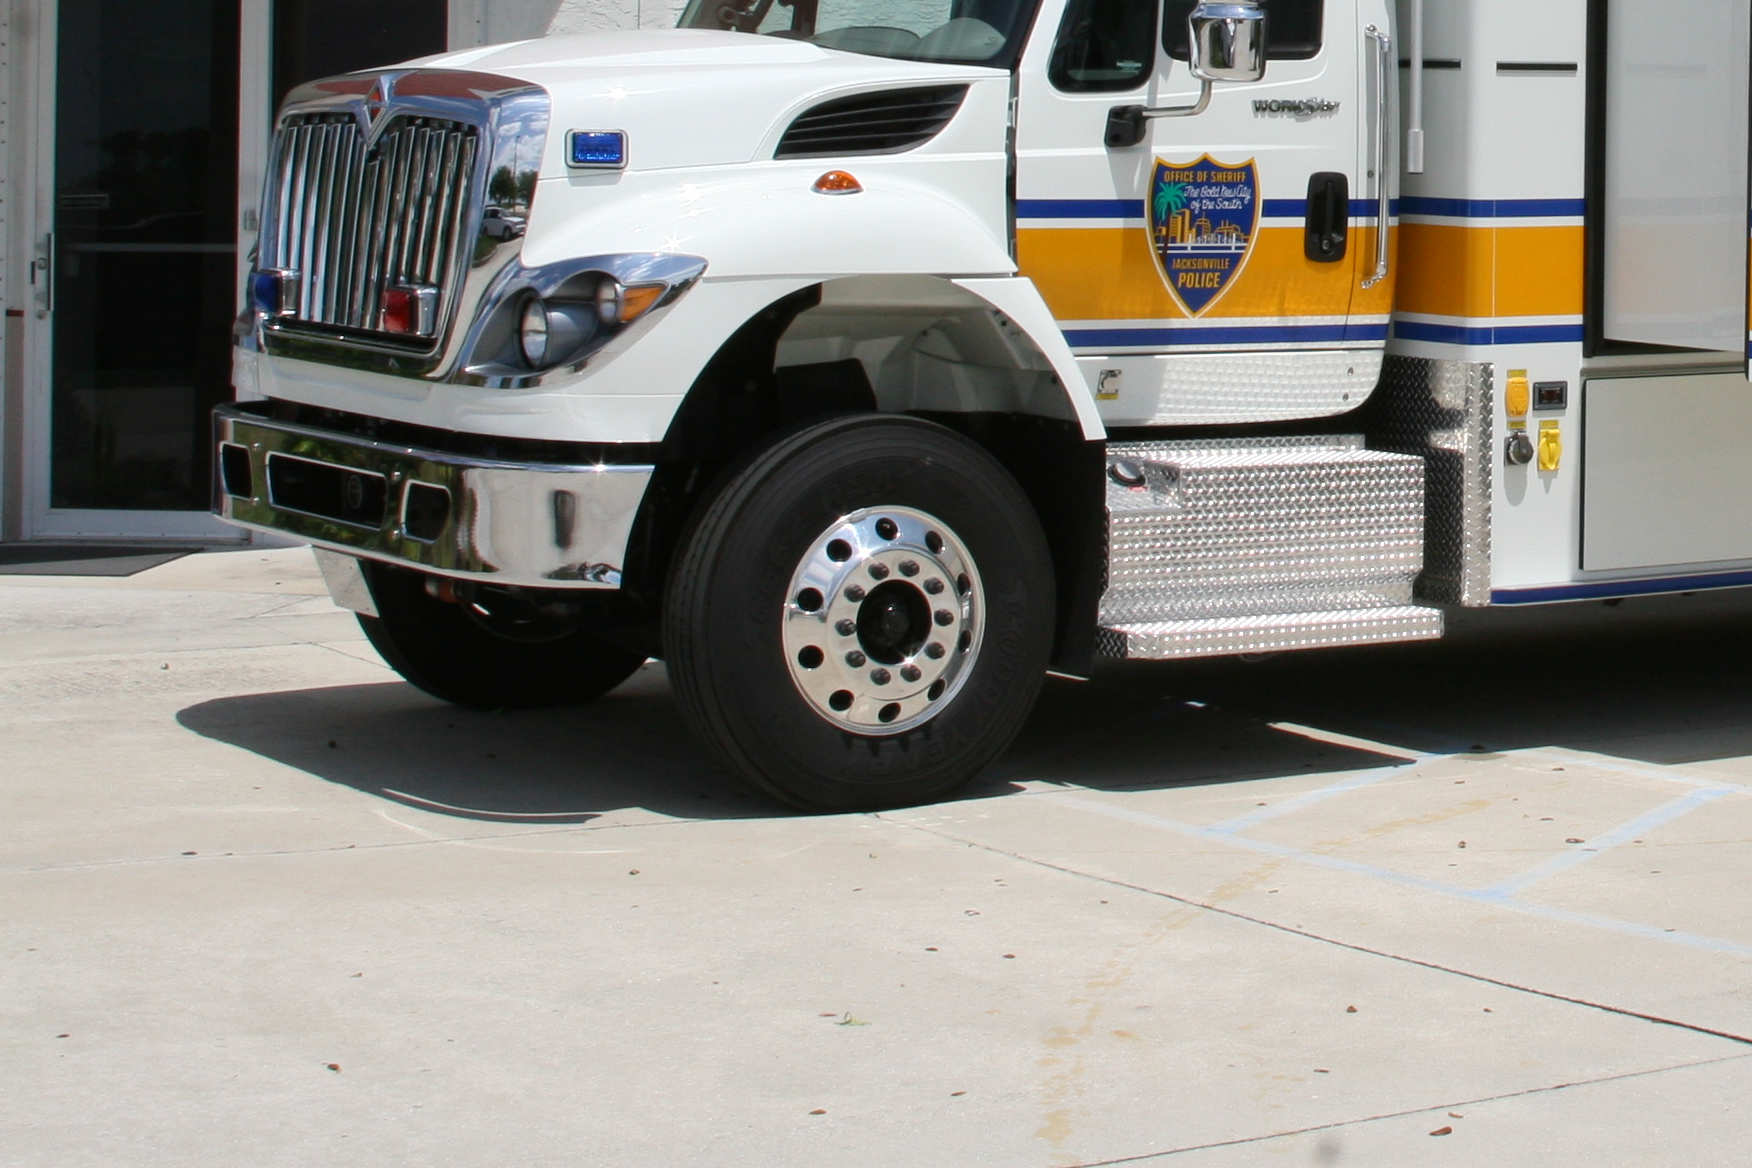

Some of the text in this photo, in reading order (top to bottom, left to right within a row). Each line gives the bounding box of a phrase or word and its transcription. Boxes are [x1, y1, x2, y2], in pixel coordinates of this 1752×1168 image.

[1164, 171, 1247, 183] OFFICE OF SHERIFF
[1184, 185, 1200, 197] The
[1190, 198, 1242, 214] of the South
[1172, 258, 1230, 270] JACKSONVILLE
[1177, 271, 1221, 288] POLICE
